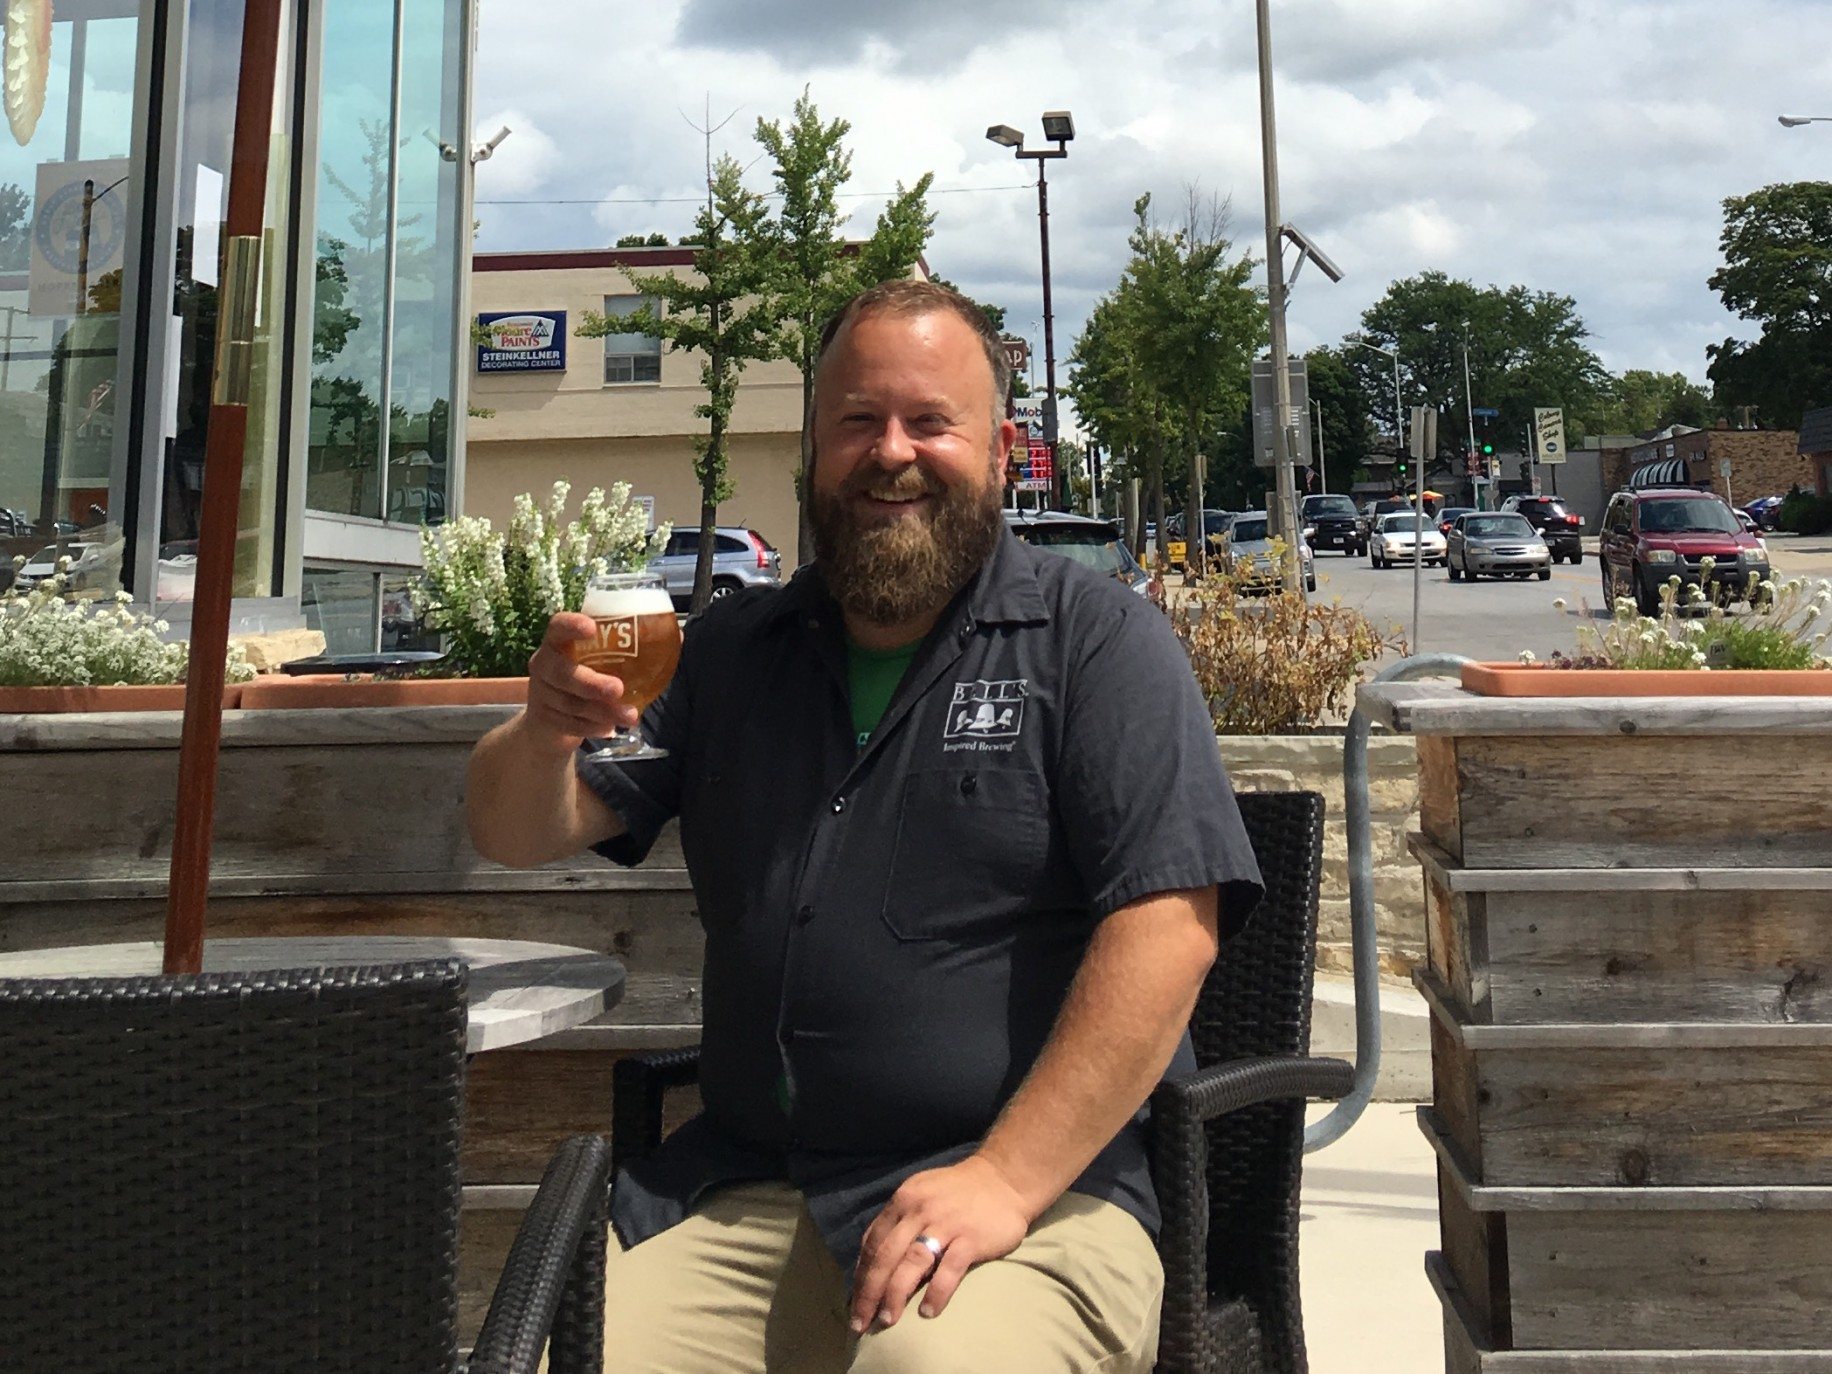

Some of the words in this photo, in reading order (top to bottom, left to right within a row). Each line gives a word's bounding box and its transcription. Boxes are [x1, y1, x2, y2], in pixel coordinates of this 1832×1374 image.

[502, 335, 540, 347] PAINTS
[482, 351, 560, 361] STEINKELLNER
[481, 361, 529, 369] DECORATING
[1017, 406, 1043, 417] Mob
[1542, 429, 1559, 441] Shop
[953, 681, 1028, 700] BLL'S
[943, 741, 977, 753] Inspired
